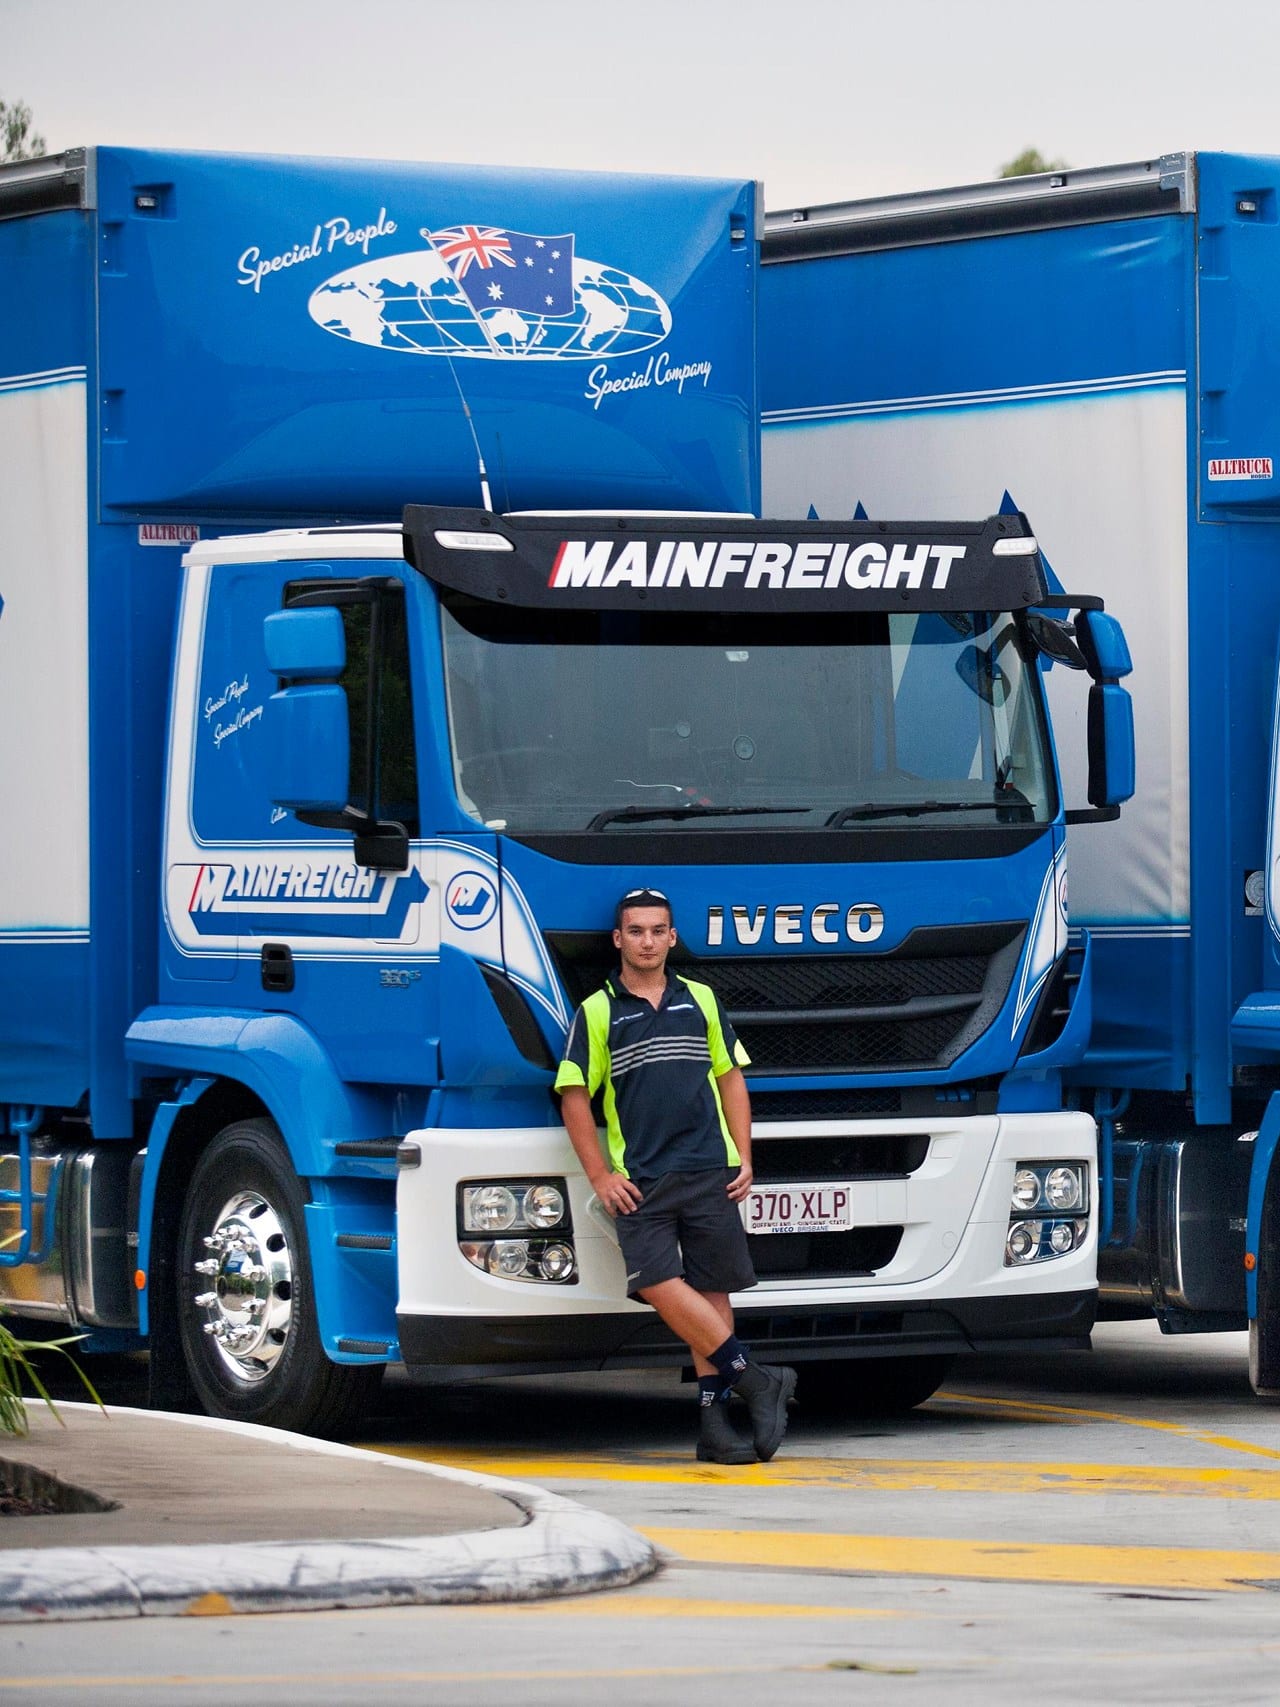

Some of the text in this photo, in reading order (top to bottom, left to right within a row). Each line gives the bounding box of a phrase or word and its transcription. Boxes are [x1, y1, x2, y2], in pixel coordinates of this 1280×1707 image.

[236, 207, 397, 293] Special People
[584, 352, 712, 410] Special Company
[1210, 459, 1271, 475] ALLTRUCK
[141, 525, 198, 540] ALLTRUCK
[547, 541, 967, 590] MAINFREIGHT
[188, 863, 412, 914] MAINFREIGHT
[706, 902, 884, 946] IVECO
